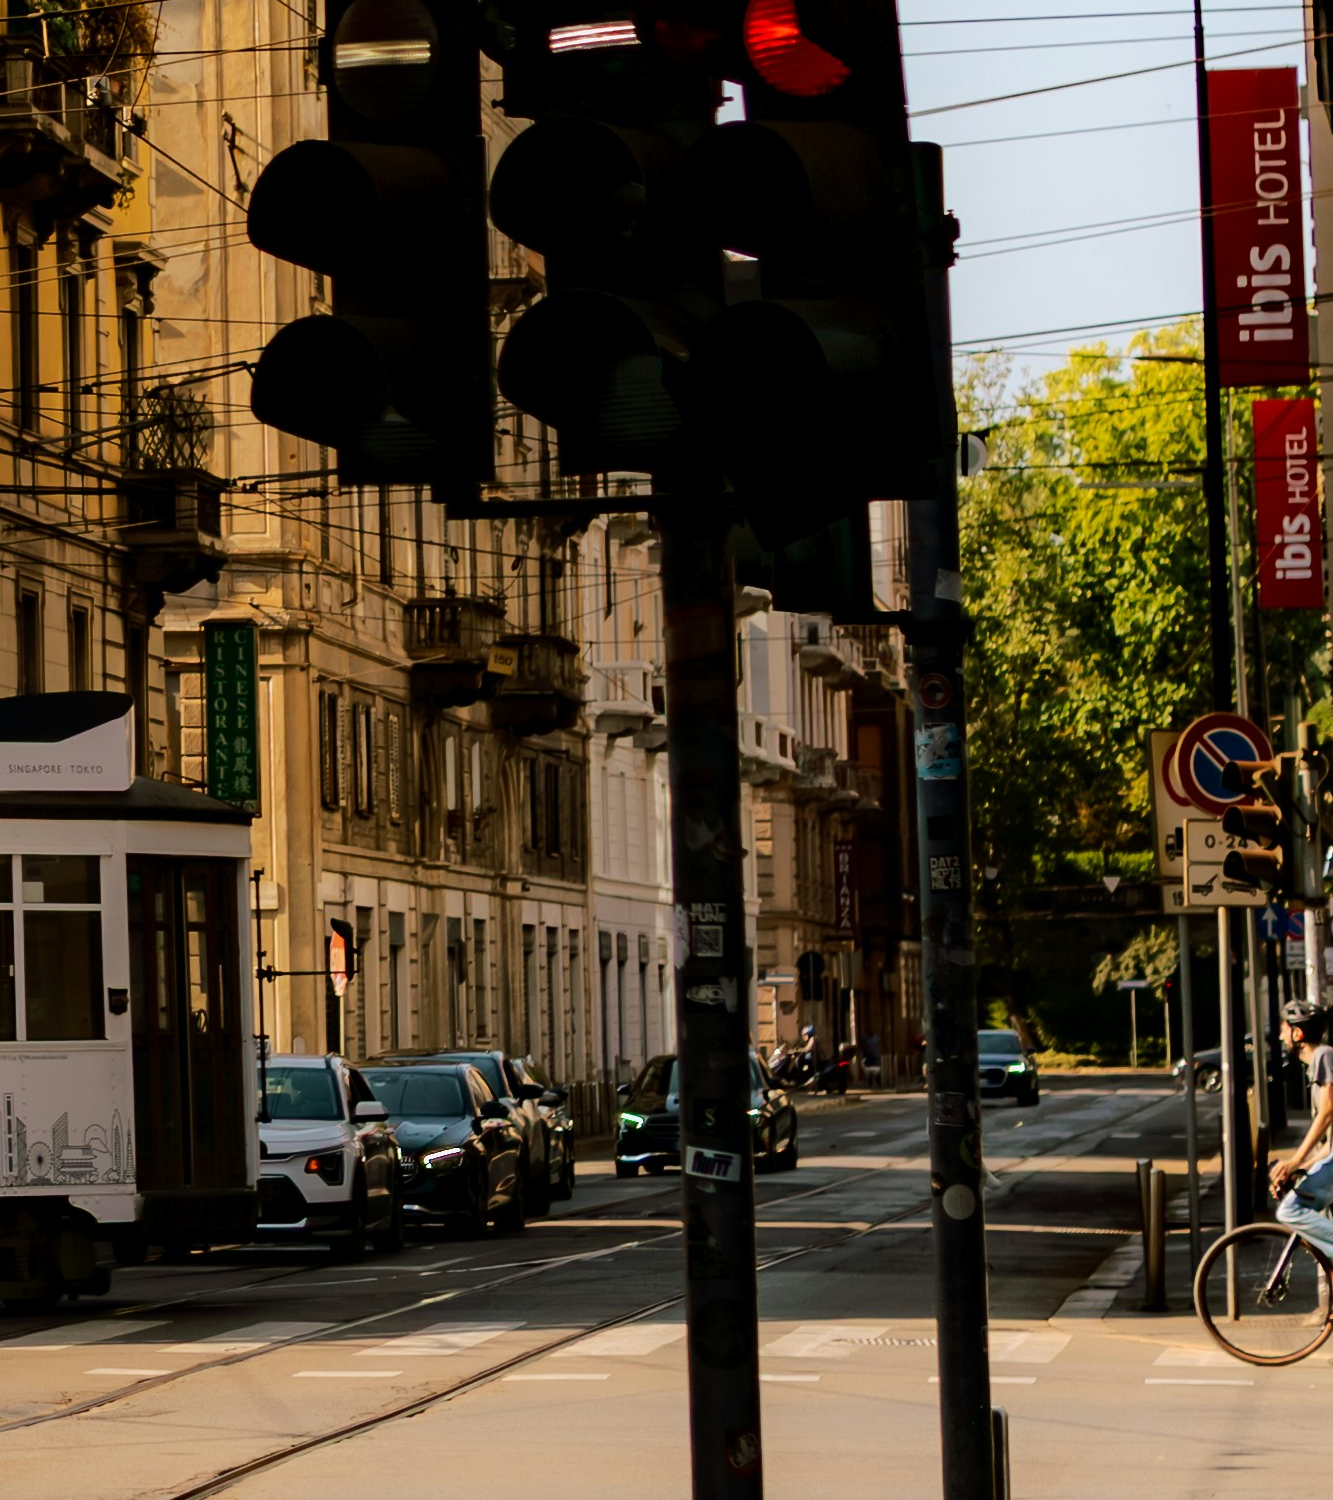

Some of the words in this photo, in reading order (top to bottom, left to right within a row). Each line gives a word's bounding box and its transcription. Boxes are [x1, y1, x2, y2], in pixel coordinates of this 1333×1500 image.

[1254, 108, 1289, 225] HOTEL
[1237, 244, 1294, 342] ibis
[1285, 426, 1310, 504] HOTEL
[1274, 514, 1312, 580] ibis
[213, 630, 229, 797] RISTORANTE
[234, 630, 248, 729] CINESE
[8, 764, 62, 774] SINGAPORE
[70, 765, 104, 774] TOKYO
